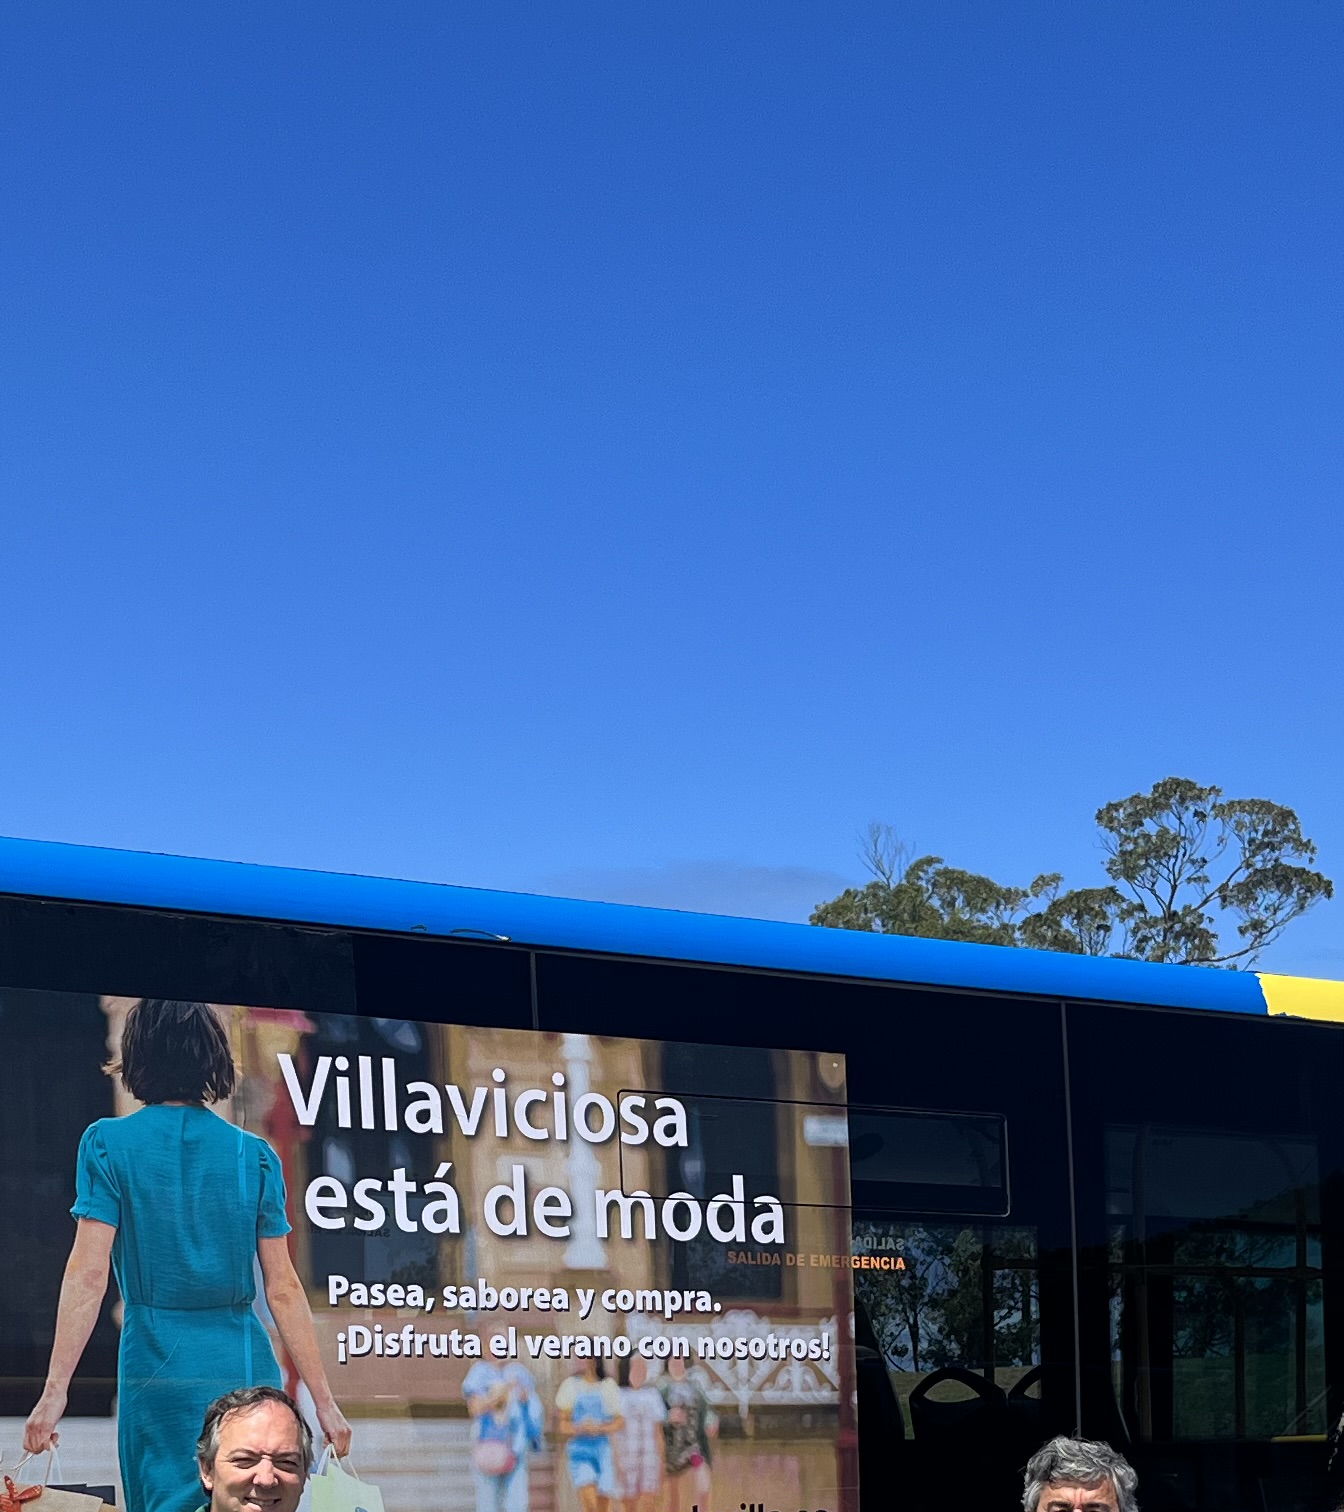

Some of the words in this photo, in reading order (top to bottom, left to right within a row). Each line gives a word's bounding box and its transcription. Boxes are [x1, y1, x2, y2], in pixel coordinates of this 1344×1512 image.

[276, 1053, 688, 1148] Villaviciosa
[304, 1162, 460, 1234] está
[483, 1165, 572, 1238] de
[595, 1175, 785, 1244] moda
[728, 1250, 782, 1267] SALIDA
[786, 1252, 805, 1267] DE
[810, 1253, 906, 1271] EMERGENCIA
[328, 1275, 435, 1313] Pasea,
[443, 1277, 570, 1310] saborea
[577, 1288, 595, 1320] y
[601, 1288, 722, 1318] compra.
[336, 1325, 482, 1362] ¡Disfruta
[489, 1327, 517, 1358] el
[524, 1334, 632, 1360] verano
[638, 1334, 690, 1360] con
[698, 1332, 831, 1361] nosotros!
